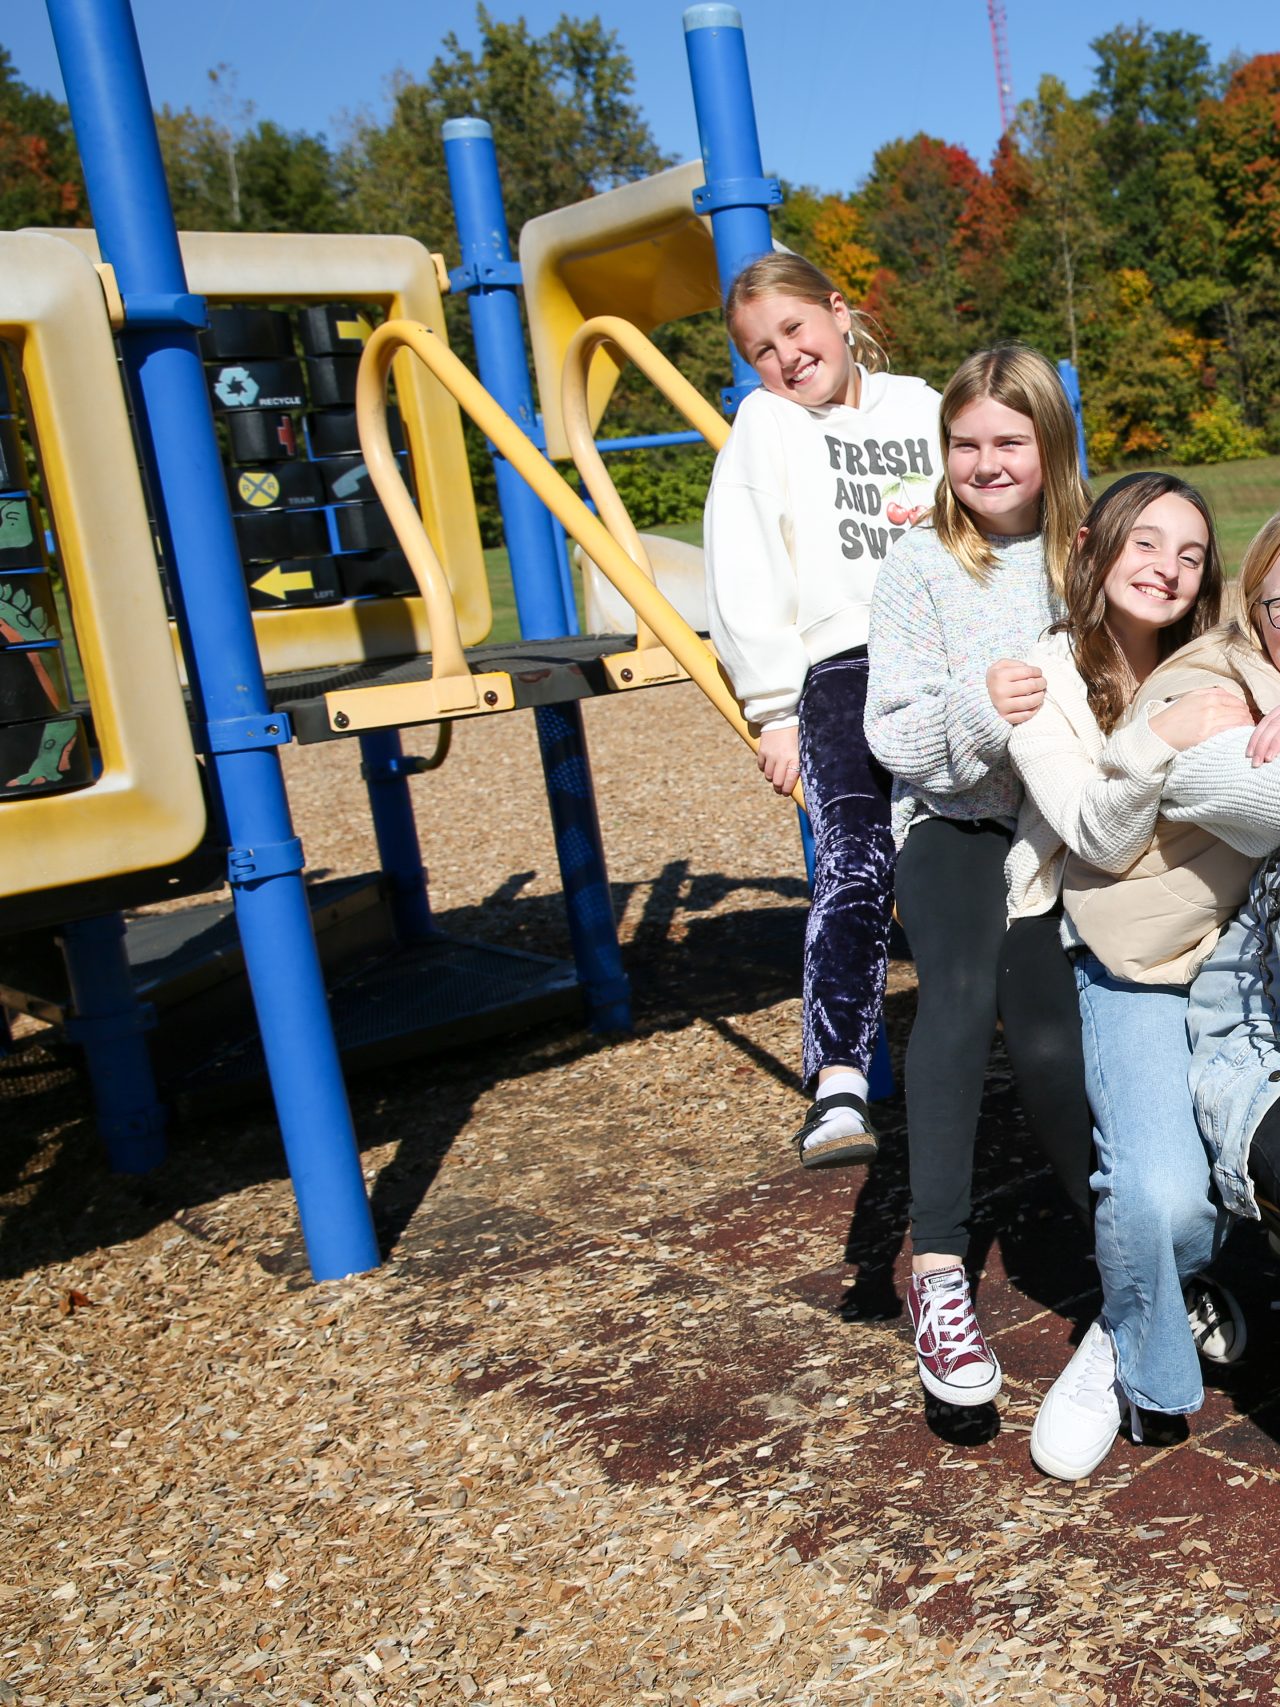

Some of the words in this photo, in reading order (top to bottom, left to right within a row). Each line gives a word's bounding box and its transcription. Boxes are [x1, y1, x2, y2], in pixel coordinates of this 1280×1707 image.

[259, 396, 302, 406] RECYCLE
[824, 434, 934, 477] FRESH
[242, 484, 251, 493] R
[267, 482, 276, 490] R
[287, 496, 316, 505] TRAIN
[834, 477, 882, 516] AND
[313, 590, 335, 600] LEFT
